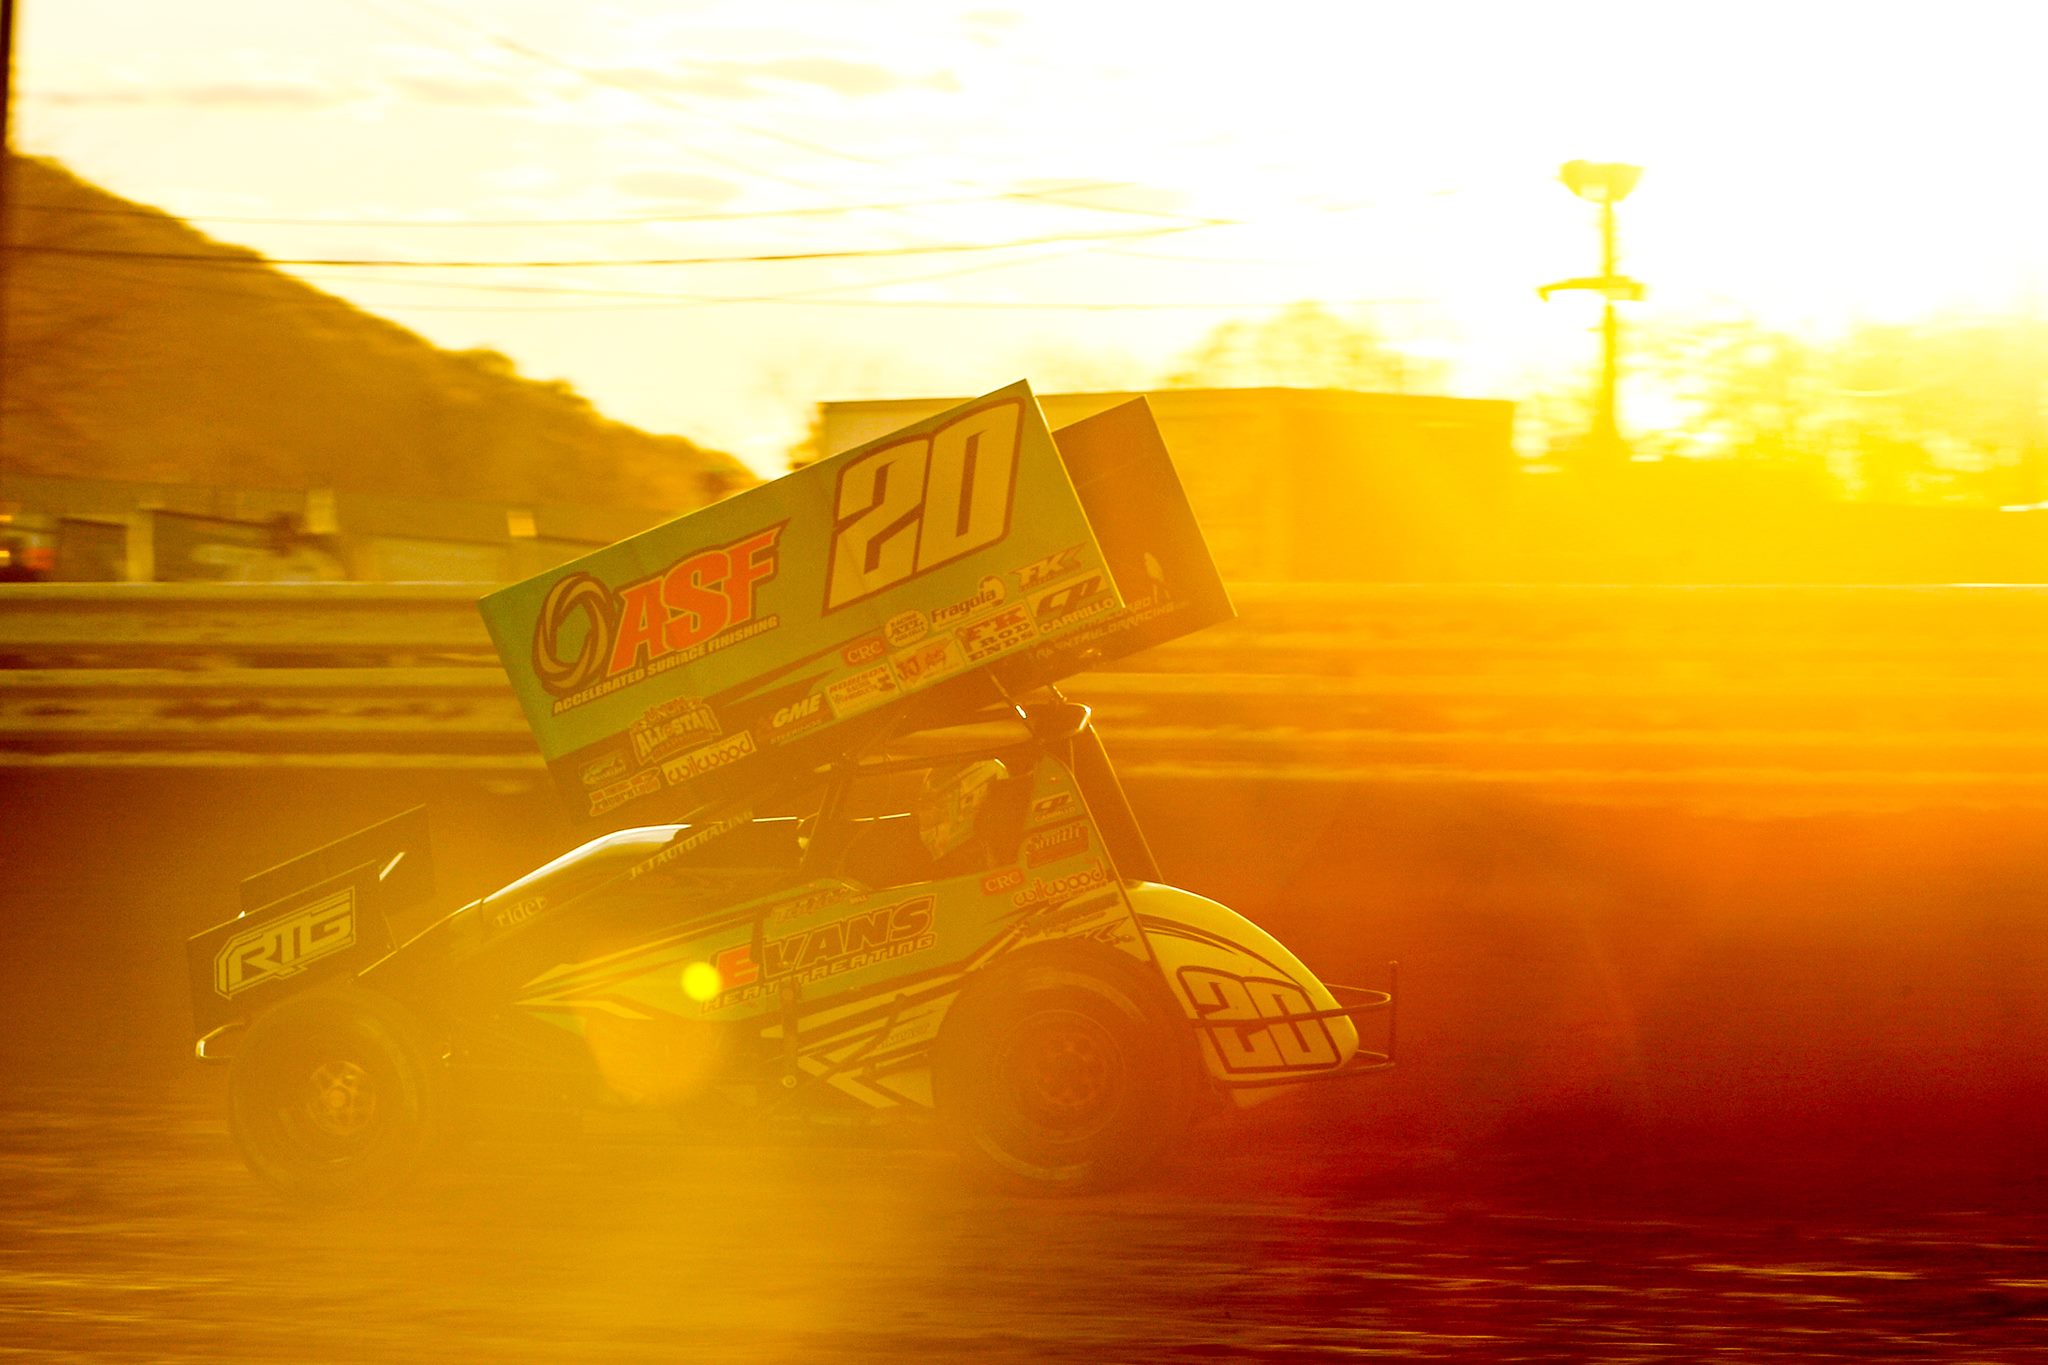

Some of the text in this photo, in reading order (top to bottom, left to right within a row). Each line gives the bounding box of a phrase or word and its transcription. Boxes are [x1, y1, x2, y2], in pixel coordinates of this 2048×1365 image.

[823, 397, 1025, 616] 20
[605, 524, 784, 678] ASF
[930, 590, 996, 623] Fragola
[1040, 598, 1115, 633] CARRILLO
[847, 640, 881, 663] CRC
[968, 631, 1034, 661] ENDS
[980, 622, 1030, 645] ROD
[553, 615, 780, 714] ACCELERATED SURFACE FINISHING
[635, 725, 667, 758] ALL
[671, 708, 717, 739] STAR
[771, 692, 823, 728] GME
[666, 731, 752, 784] wilwood
[1013, 859, 1107, 908] wilwood
[495, 896, 547, 926] rider
[222, 893, 354, 995] RTG
[713, 895, 936, 992] EVANS
[701, 933, 937, 1014] HEAT TREATING
[1175, 965, 1342, 1074] 20
